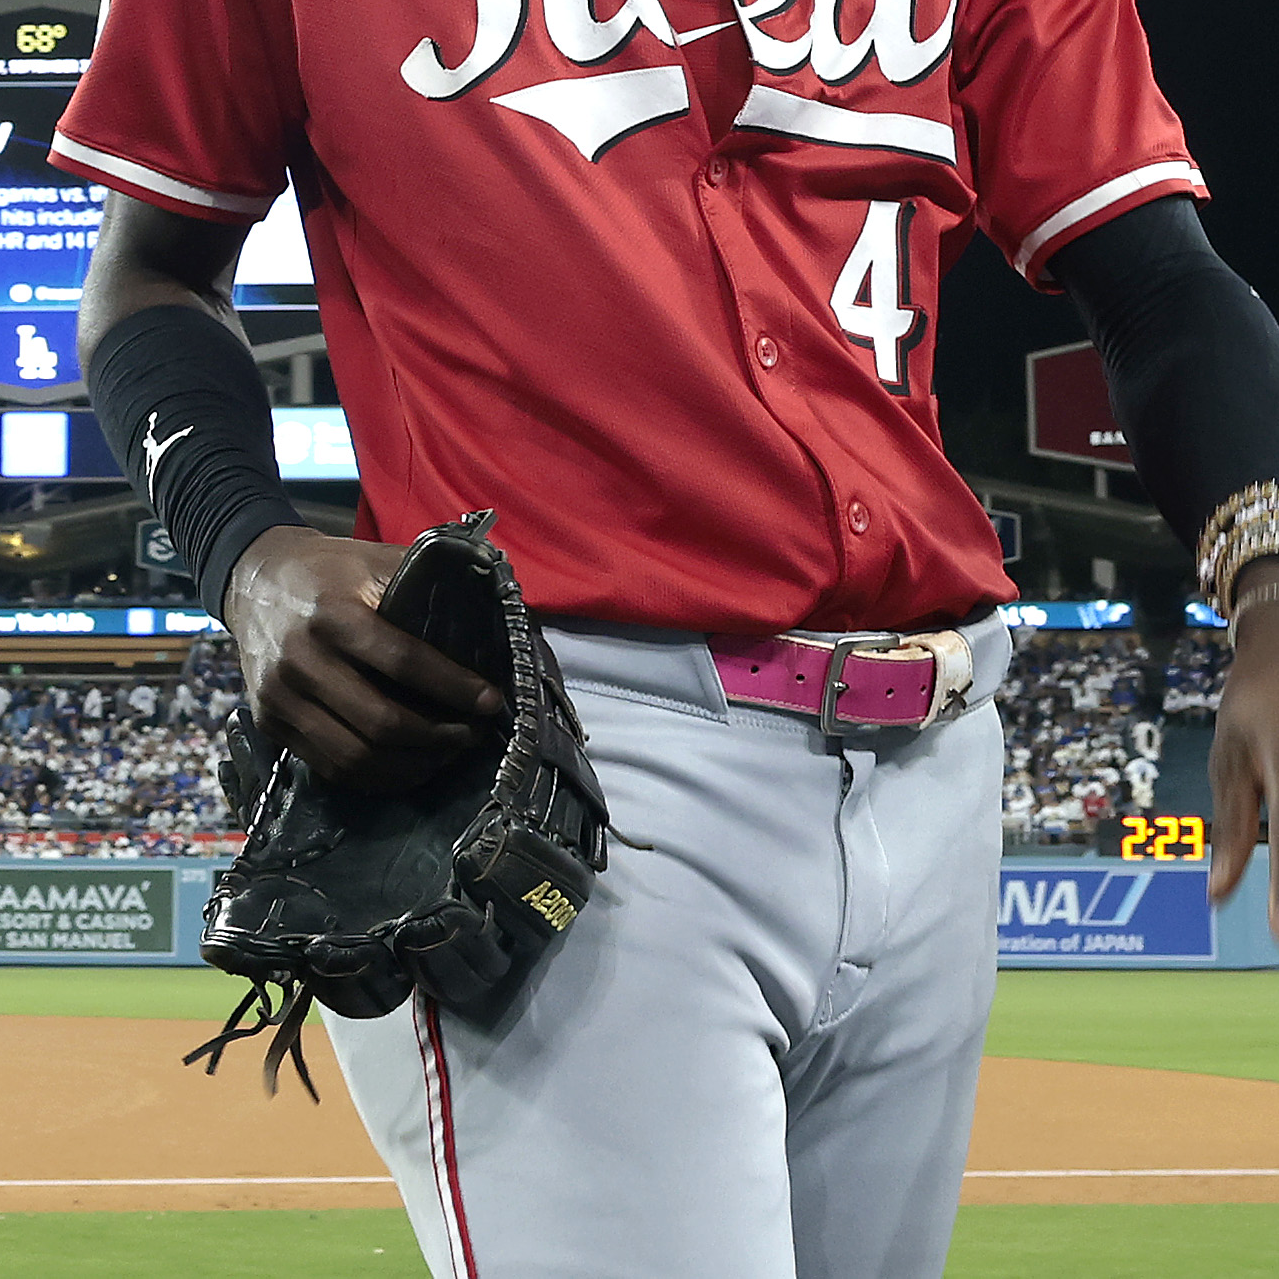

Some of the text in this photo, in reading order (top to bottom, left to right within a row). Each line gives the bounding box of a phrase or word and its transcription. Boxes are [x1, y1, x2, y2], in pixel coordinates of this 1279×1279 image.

[25, 232, 63, 250] and
[830, 200, 928, 396] 4
[1121, 816, 1205, 861] 2:23
[998, 880, 1081, 926] NA
[57, 913, 72, 930] &
[75, 913, 154, 931] CASINO
[5, 931, 48, 948] SAN
[51, 932, 136, 949] MANUEL
[1083, 934, 1145, 952] JAPAN
